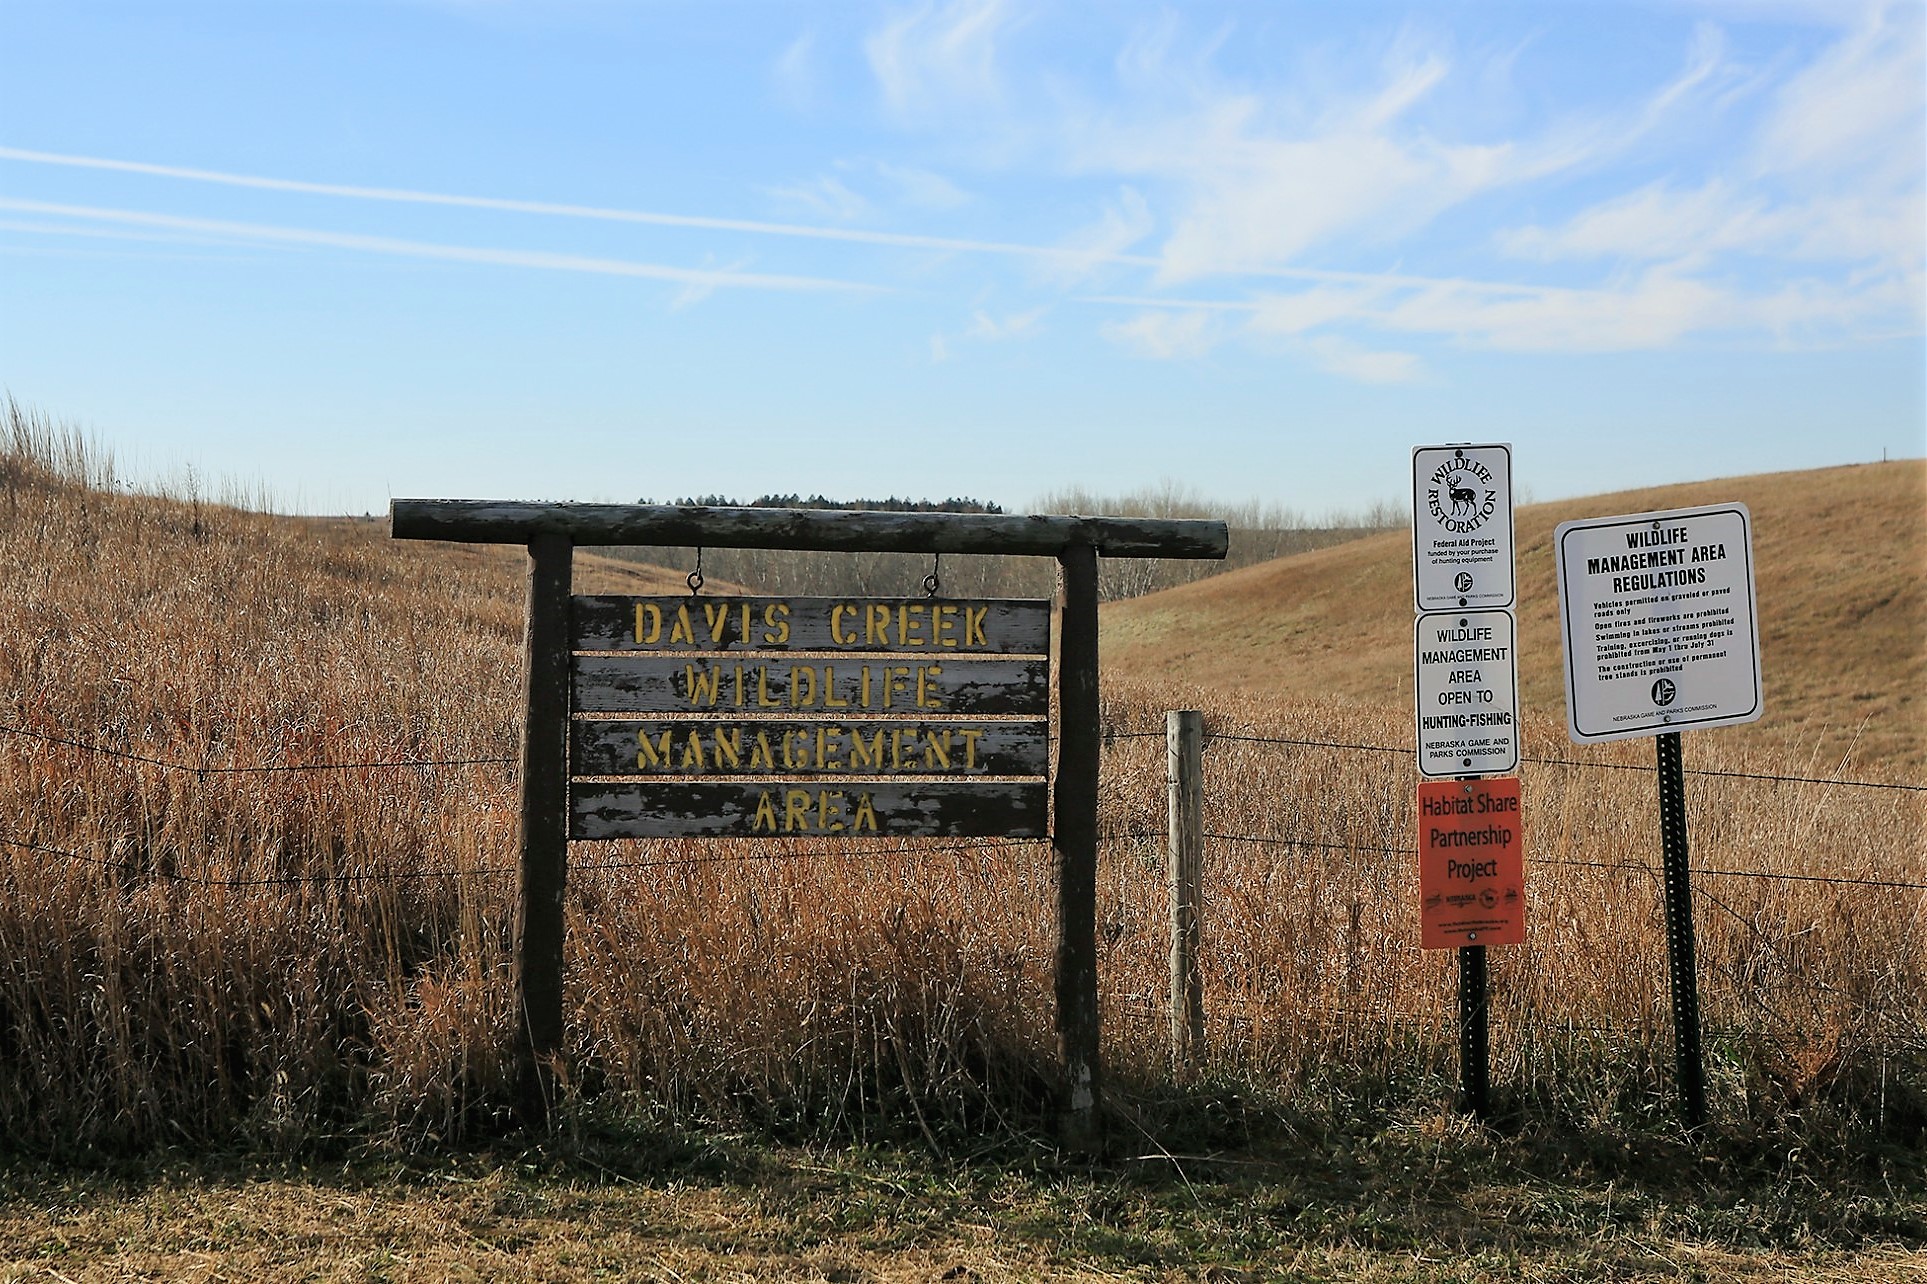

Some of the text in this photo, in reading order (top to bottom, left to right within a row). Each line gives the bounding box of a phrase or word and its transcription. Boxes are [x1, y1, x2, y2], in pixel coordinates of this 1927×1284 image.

[1431, 458, 1492, 485] WILDLIFE
[1428, 489, 1496, 534] RESTORATION
[1471, 538, 1495, 546] Project
[1626, 528, 1688, 548] WILDLIFE
[1588, 544, 1726, 575] MANAGEMENT AREA
[1614, 568, 1705, 593] REGULATIONS
[1594, 600, 1622, 610] Vehicles
[1625, 596, 1658, 606] permitted
[1671, 591, 1700, 601] graveled
[1711, 587, 1730, 597] paved
[633, 602, 989, 647] DAVIS CREEK
[1595, 622, 1612, 630] Open
[1648, 614, 1680, 624] fireworks
[1696, 608, 1729, 618] prohibited
[1595, 632, 1630, 641] Swimming
[1642, 627, 1660, 635] lakes
[1672, 623, 1699, 632] streams
[1702, 618, 1734, 629] prohibited
[1437, 628, 1492, 642] WILDLIFE
[1596, 644, 1627, 652] Training,
[1682, 634, 1707, 643] running
[1422, 648, 1507, 664] MANAGEMENT
[1597, 650, 1632, 661] prohibited
[1613, 660, 1656, 671] construction
[1692, 651, 1727, 661] permanent
[1449, 670, 1481, 683] AREA
[1616, 671, 1638, 679] stands
[1649, 665, 1683, 676] prohibited
[685, 664, 942, 708] WILDLIFE
[1439, 690, 1493, 705] OPEN TO
[1684, 704, 1717, 713] COMMISSION
[1423, 712, 1511, 729] HUNTING-FISHING
[637, 727, 984, 771] MANAGEMENT
[1426, 741, 1465, 749] NEBRASKA
[1456, 748, 1505, 756] COMMISSION
[752, 790, 877, 832] AREA
[1423, 793, 1517, 816] Habitat Share
[1431, 825, 1511, 848] Partnership
[1448, 859, 1497, 882] Project
